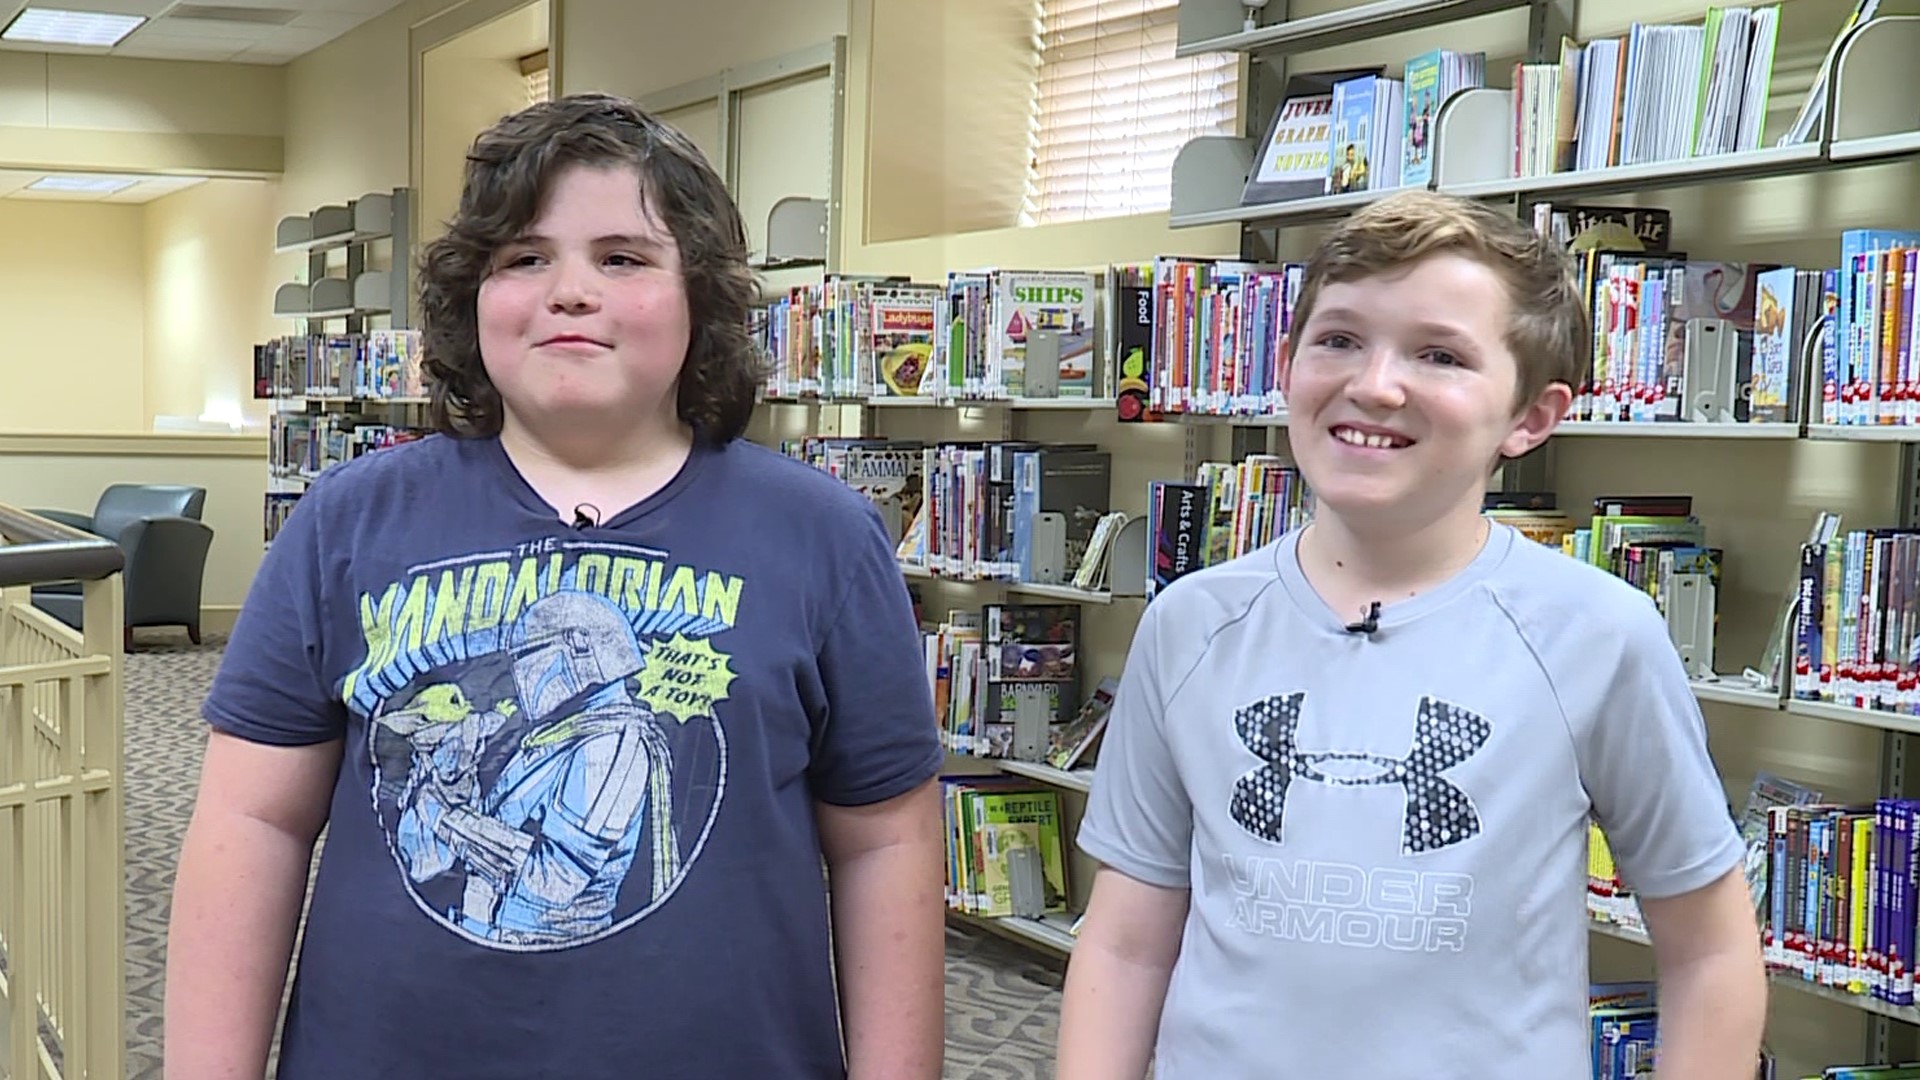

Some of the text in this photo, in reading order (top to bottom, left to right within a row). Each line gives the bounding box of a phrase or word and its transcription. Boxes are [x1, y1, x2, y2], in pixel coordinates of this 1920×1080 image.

[1013, 286, 1083, 304] SHIPS
[883, 311, 934, 326] Ladybugs
[1138, 291, 1150, 324] Food
[1175, 490, 1194, 573] Arts & Crafts
[517, 537, 558, 557] THE
[341, 552, 745, 706] MANDALORIAN
[655, 646, 722, 671] THAT'S
[661, 668, 706, 686] NOT
[644, 685, 661, 697] A
[1005, 801, 1052, 814] REPTILE
[1222, 854, 1474, 917] UNDER
[1225, 895, 1468, 952] ARMOUR
